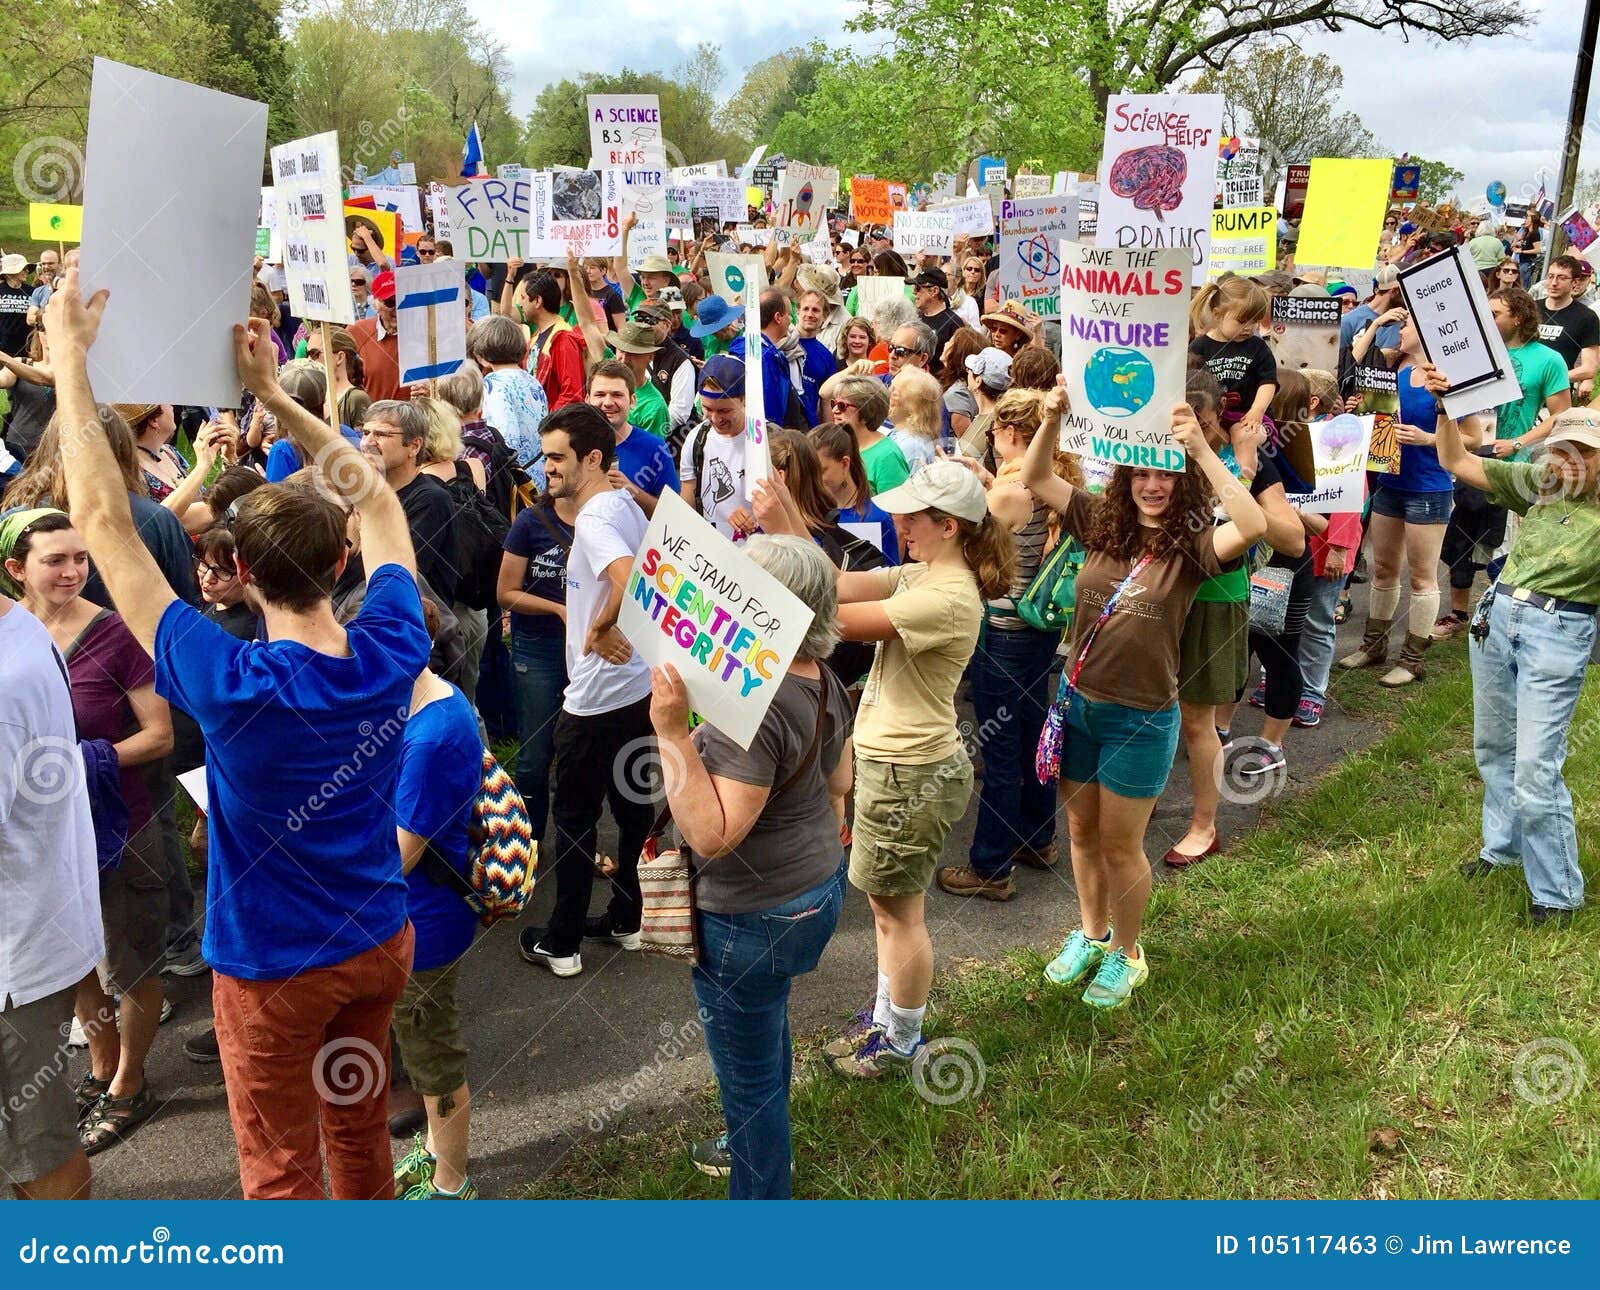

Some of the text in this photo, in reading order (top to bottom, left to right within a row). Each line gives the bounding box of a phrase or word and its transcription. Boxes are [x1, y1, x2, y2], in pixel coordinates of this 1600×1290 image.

[595, 108, 658, 122] A SCIENCE
[602, 130, 623, 144] B.S.
[1164, 128, 1212, 149] HELPS
[610, 151, 645, 164] BEATS
[682, 162, 708, 177] COME
[622, 171, 661, 186] WITTER
[1226, 180, 1260, 193] SCIENCE
[1227, 191, 1259, 205] IS TRUE
[496, 210, 519, 223] the
[856, 206, 877, 217] NOT
[1002, 201, 1034, 219] Politics
[1061, 206, 1067, 214] a
[1213, 212, 1272, 231] RUMP
[901, 235, 949, 249] NO BEER!
[1243, 244, 1264, 254] FREE
[1081, 248, 1159, 268] SAVE THE
[1243, 260, 1264, 269] FREE
[1061, 264, 1183, 297] ANIMALS
[1022, 285, 1049, 297] base
[1416, 277, 1453, 300] Science
[1089, 299, 1134, 318] SAVE
[1273, 297, 1339, 309] NoScience
[1435, 302, 1446, 312] is
[1273, 308, 1338, 320] NoChance
[1069, 314, 1170, 348] NATURE
[1438, 320, 1459, 337] NOT
[1442, 337, 1470, 357] Belief
[1355, 366, 1397, 381] NoScience
[1355, 376, 1397, 391] NoChance
[1065, 414, 1173, 446] AND YOU SAVE
[1065, 433, 1088, 450] THE
[1091, 437, 1186, 471] WORLD
[662, 524, 781, 638] WE STAND FOR
[642, 548, 780, 680] SCIENTIFIC
[629, 571, 763, 698] INTEGRITY
